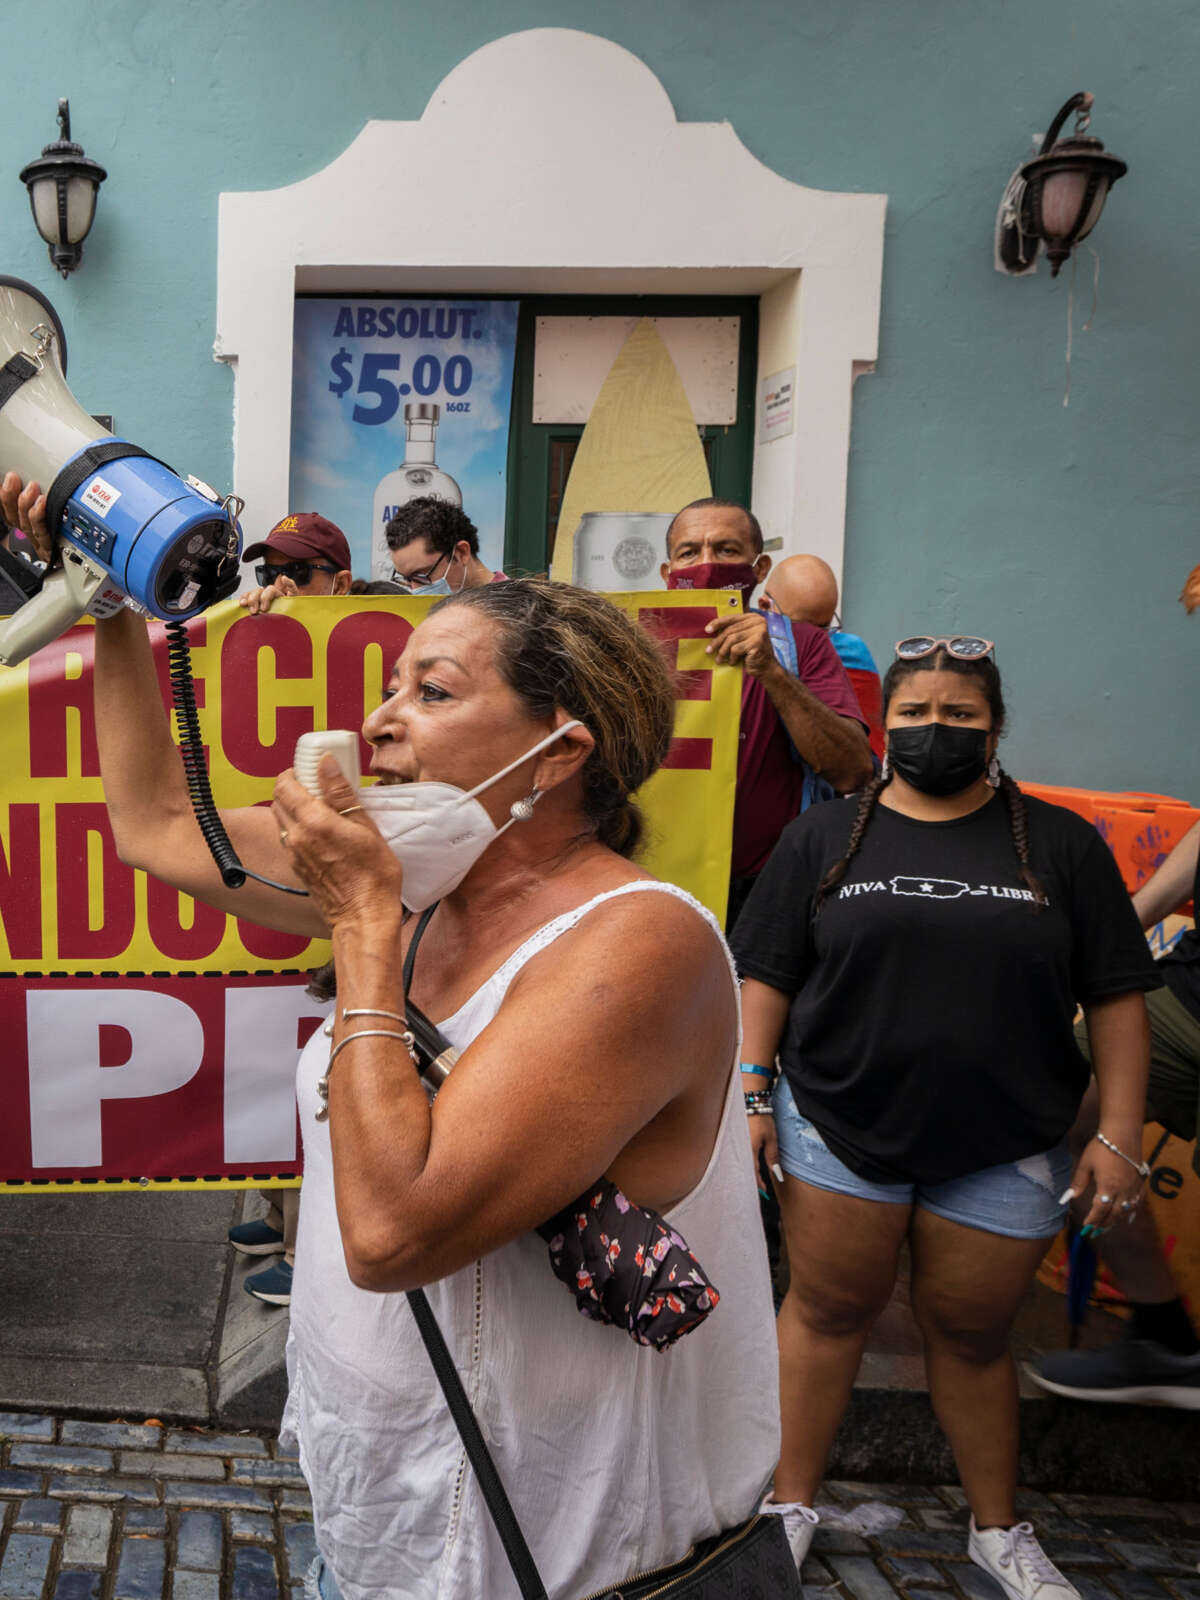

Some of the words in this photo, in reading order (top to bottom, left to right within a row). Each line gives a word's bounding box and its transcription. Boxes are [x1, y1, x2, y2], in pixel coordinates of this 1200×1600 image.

[333, 306, 483, 340] ABSOLUT.
[329, 347, 473, 426] $5.00
[839, 881, 887, 899] ¡VIVA
